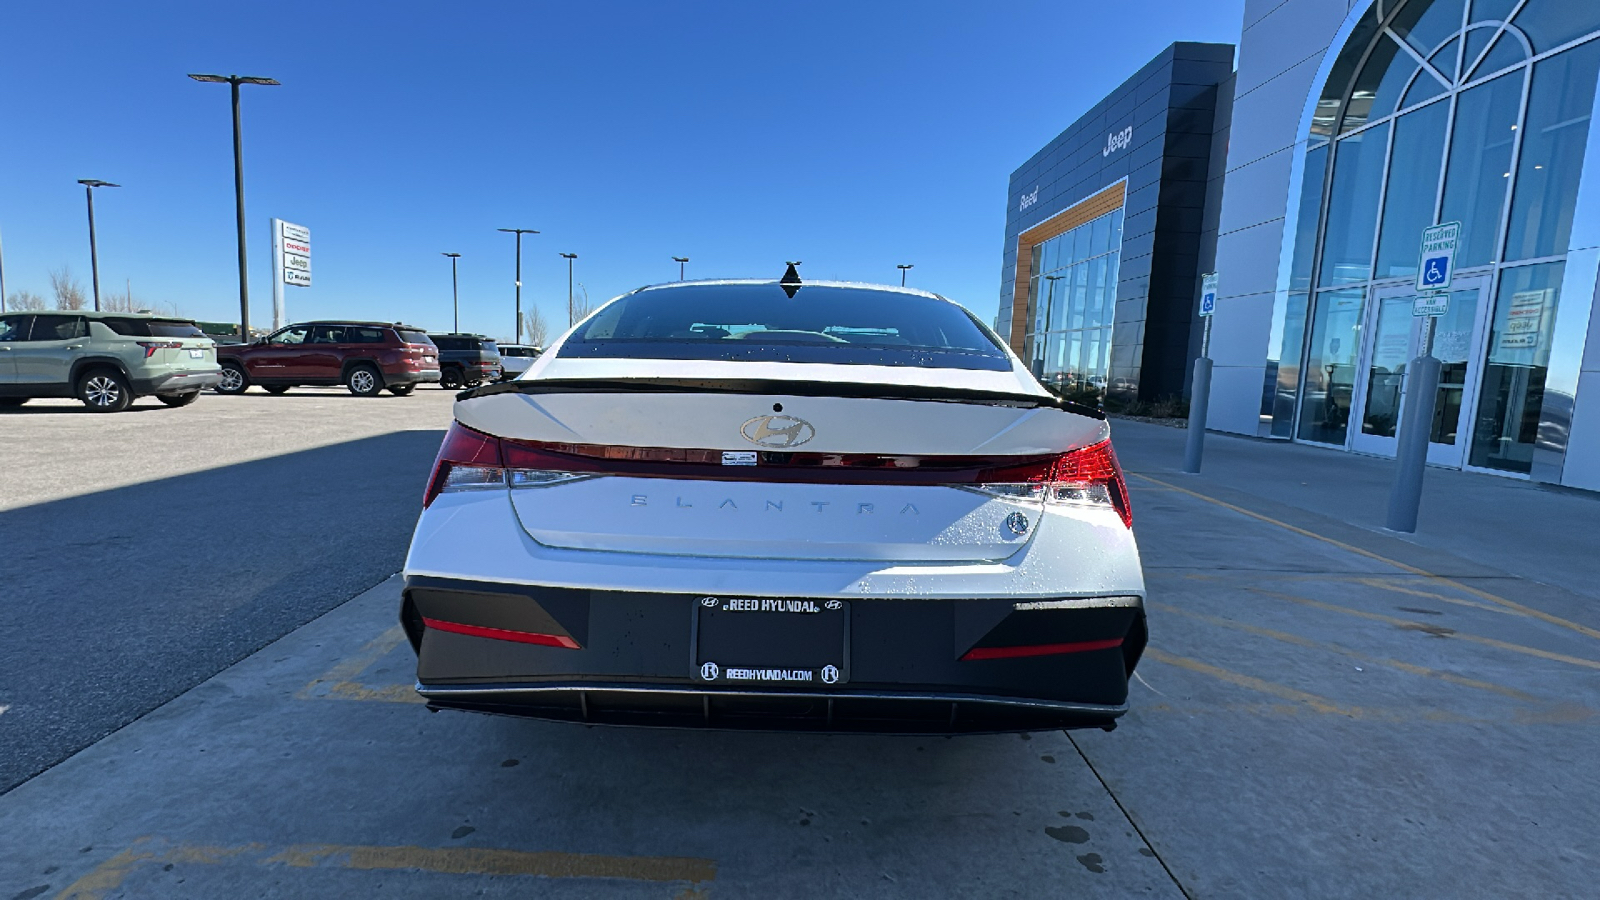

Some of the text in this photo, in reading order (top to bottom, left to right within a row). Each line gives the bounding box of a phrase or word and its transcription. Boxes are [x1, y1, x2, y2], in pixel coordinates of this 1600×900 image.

[1103, 126, 1132, 157] Jeep
[1019, 185, 1039, 212] Reed
[1425, 228, 1456, 242] RESERVED
[286, 242, 310, 252] DODGE
[1423, 240, 1454, 253] PARKING
[290, 256, 307, 268] Jeep
[1414, 304, 1446, 313] ACCESSIBLE
[630, 494, 919, 514] ELANTRA
[730, 599, 814, 613] REED HYUNDAI
